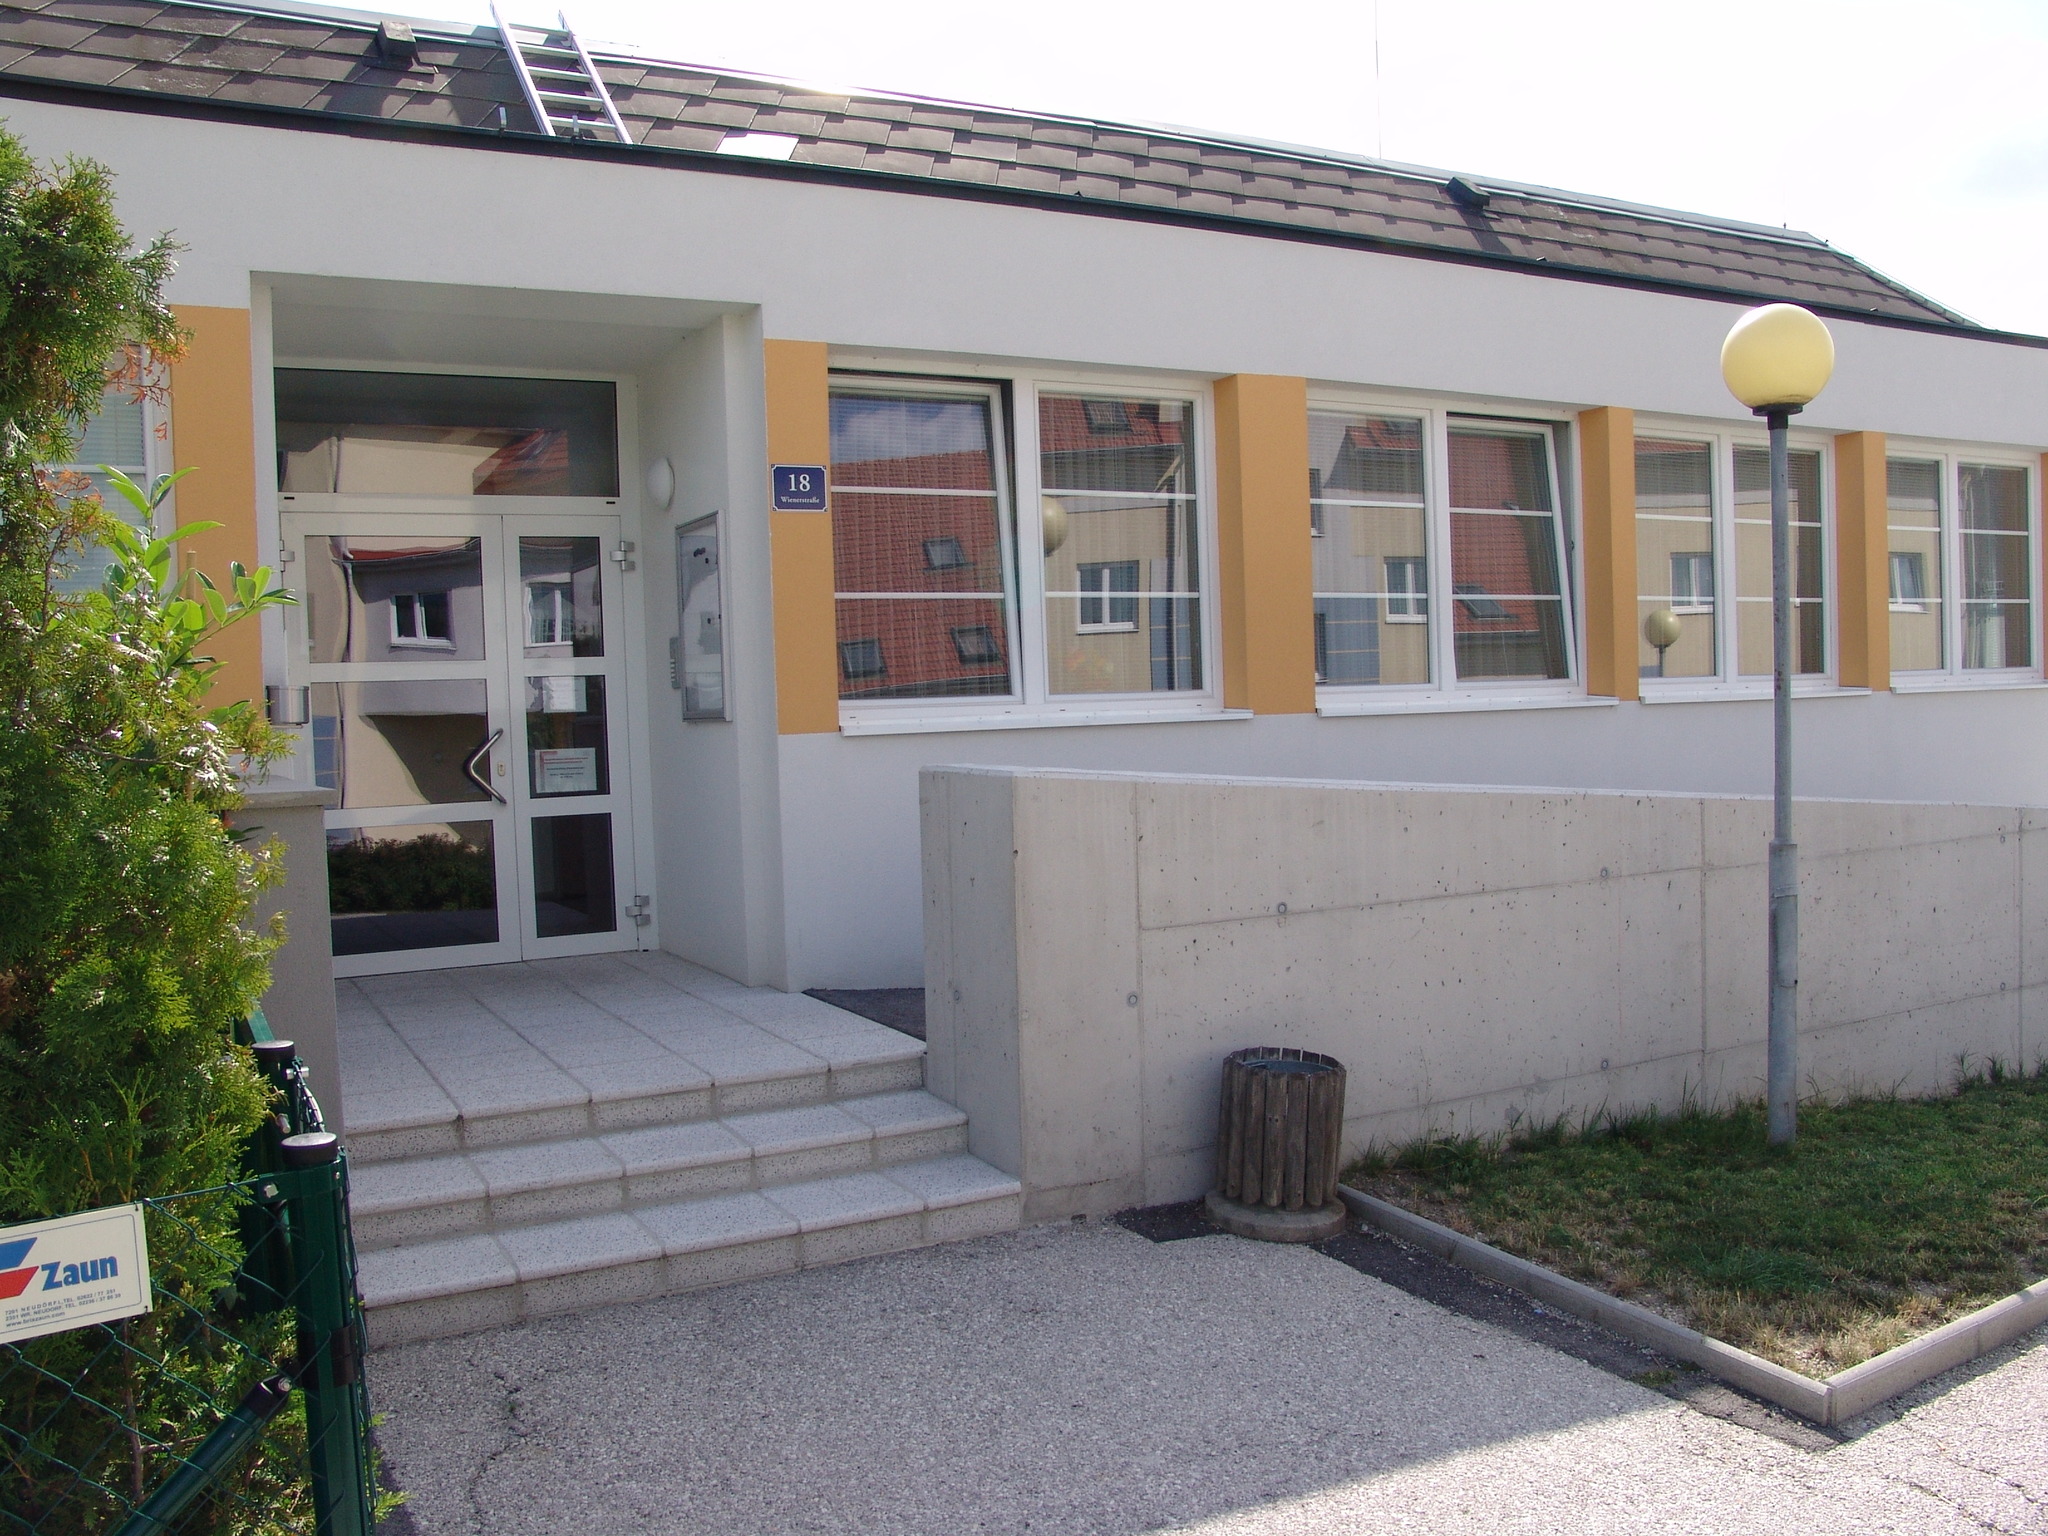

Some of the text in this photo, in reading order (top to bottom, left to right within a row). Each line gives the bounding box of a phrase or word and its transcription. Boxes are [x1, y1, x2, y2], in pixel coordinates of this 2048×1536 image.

[788, 474, 811, 491] 18
[780, 495, 820, 504] Wienerstraße
[41, 1255, 119, 1291] Zaun
